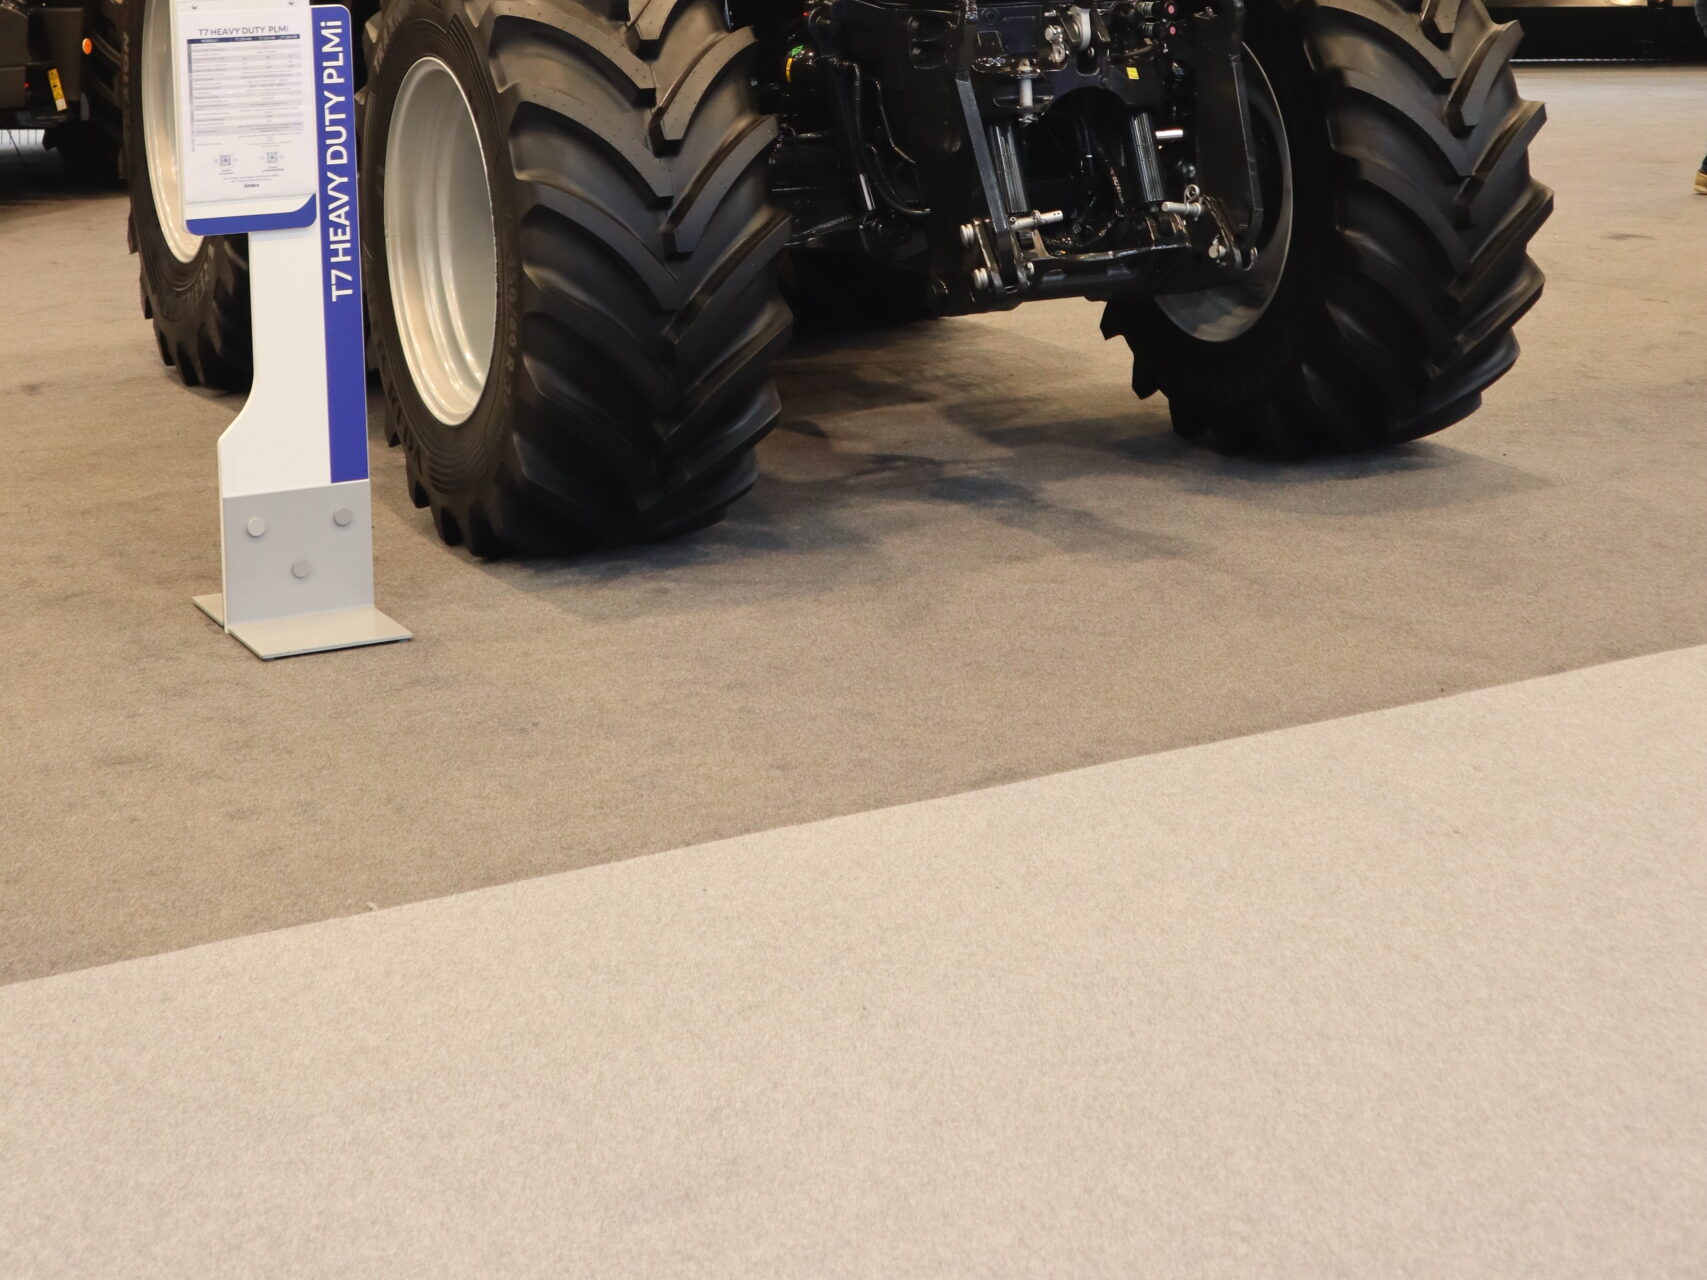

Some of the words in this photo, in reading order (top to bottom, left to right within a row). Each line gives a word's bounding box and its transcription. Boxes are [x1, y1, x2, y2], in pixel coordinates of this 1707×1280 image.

[211, 27, 240, 35] HEAVY
[242, 26, 266, 34] DUTY
[269, 25, 288, 33] PLMi
[320, 20, 345, 84] PLMi
[324, 91, 348, 165] DUTY
[328, 171, 351, 263] HEAVY
[331, 269, 353, 302] T7
